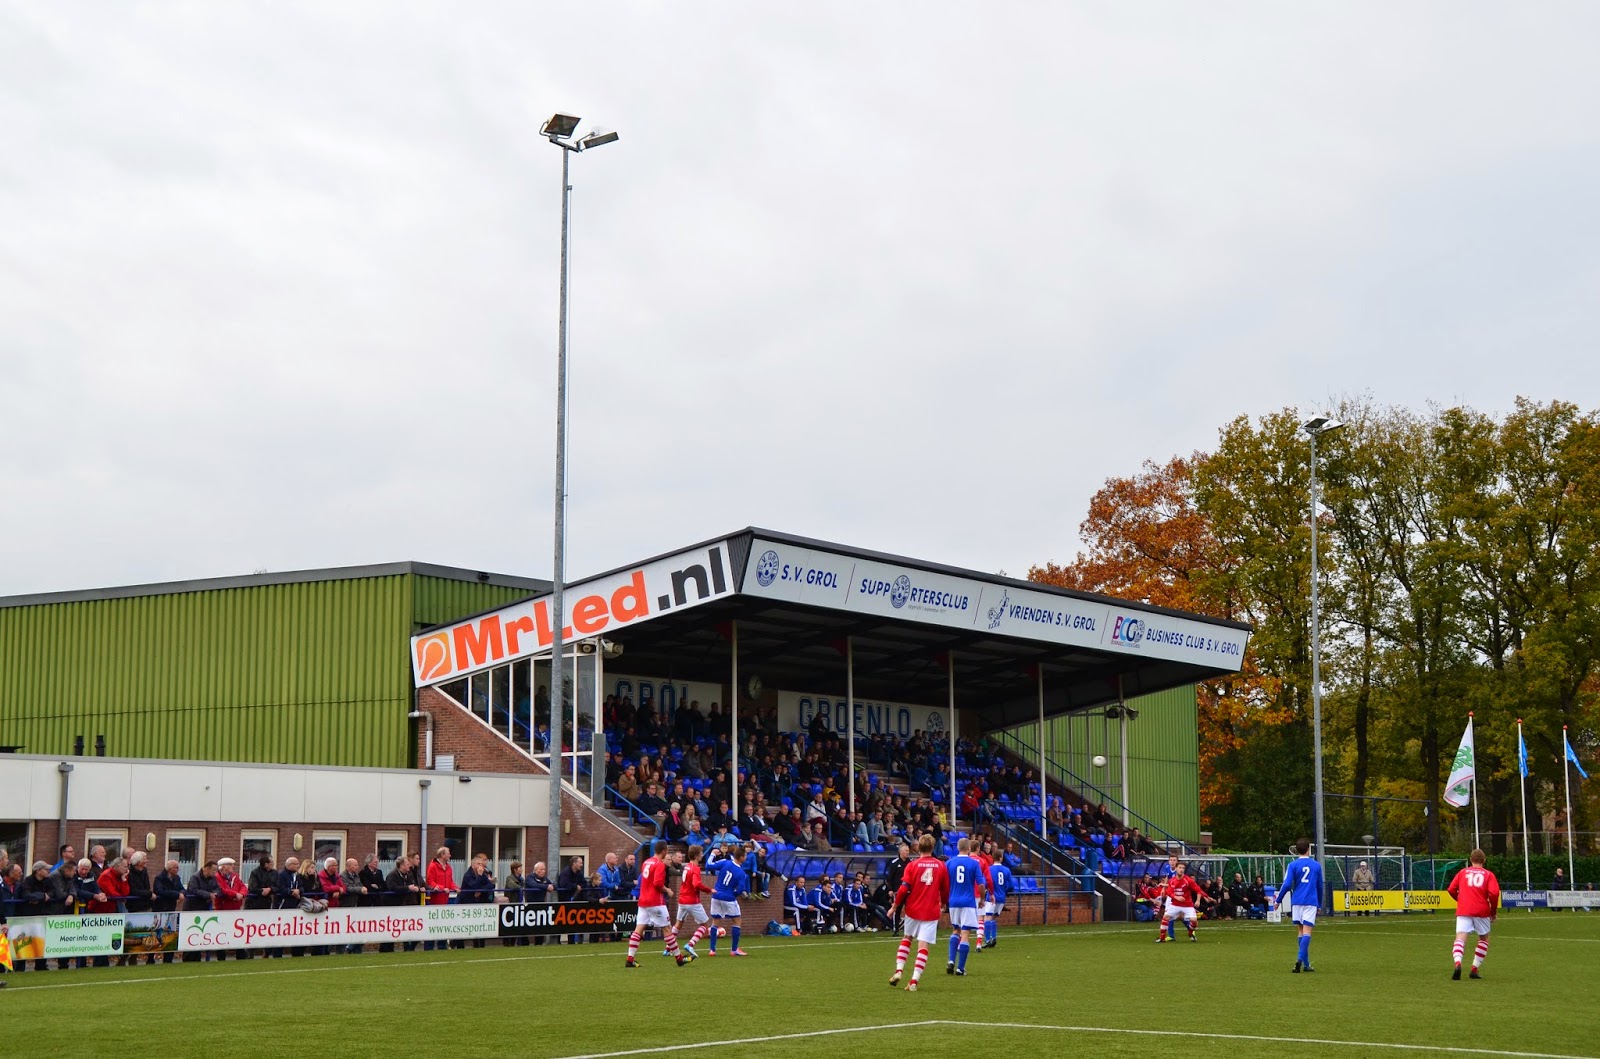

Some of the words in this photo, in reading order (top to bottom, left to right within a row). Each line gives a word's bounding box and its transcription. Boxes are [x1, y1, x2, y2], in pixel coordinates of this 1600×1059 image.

[781, 564, 803, 583] S.V.
[806, 568, 838, 588] GROL
[452, 547, 726, 671] MrLed.nl
[1009, 604, 1055, 624] VRIENDEN
[1055, 612, 1072, 627] S.V.
[1073, 615, 1096, 631] GROL
[1146, 628, 1184, 646] BUSINESS
[1185, 635, 1205, 649] CLUB
[1206, 639, 1220, 653] S.V.
[1220, 641, 1240, 655] GROL
[722, 870, 733, 886] 11
[920, 867, 933, 885] 4
[956, 865, 965, 884] 6
[997, 871, 1004, 885] 8
[1301, 866, 1310, 883] 2
[1465, 872, 1485, 888] 10
[1350, 892, 1385, 909] dusseldorp
[1409, 892, 1441, 907] dusseldorp
[428, 910, 439, 920] tel
[441, 909, 455, 919] 036
[461, 909, 471, 919] 54
[472, 908, 482, 918] 89
[483, 908, 497, 918] 320
[233, 916, 319, 944] Specialist
[324, 915, 340, 935] in
[345, 914, 424, 938] kunstgras
[428, 921, 496, 936] www.cscsport.nl
[187, 932, 230, 946] C.S.C.
